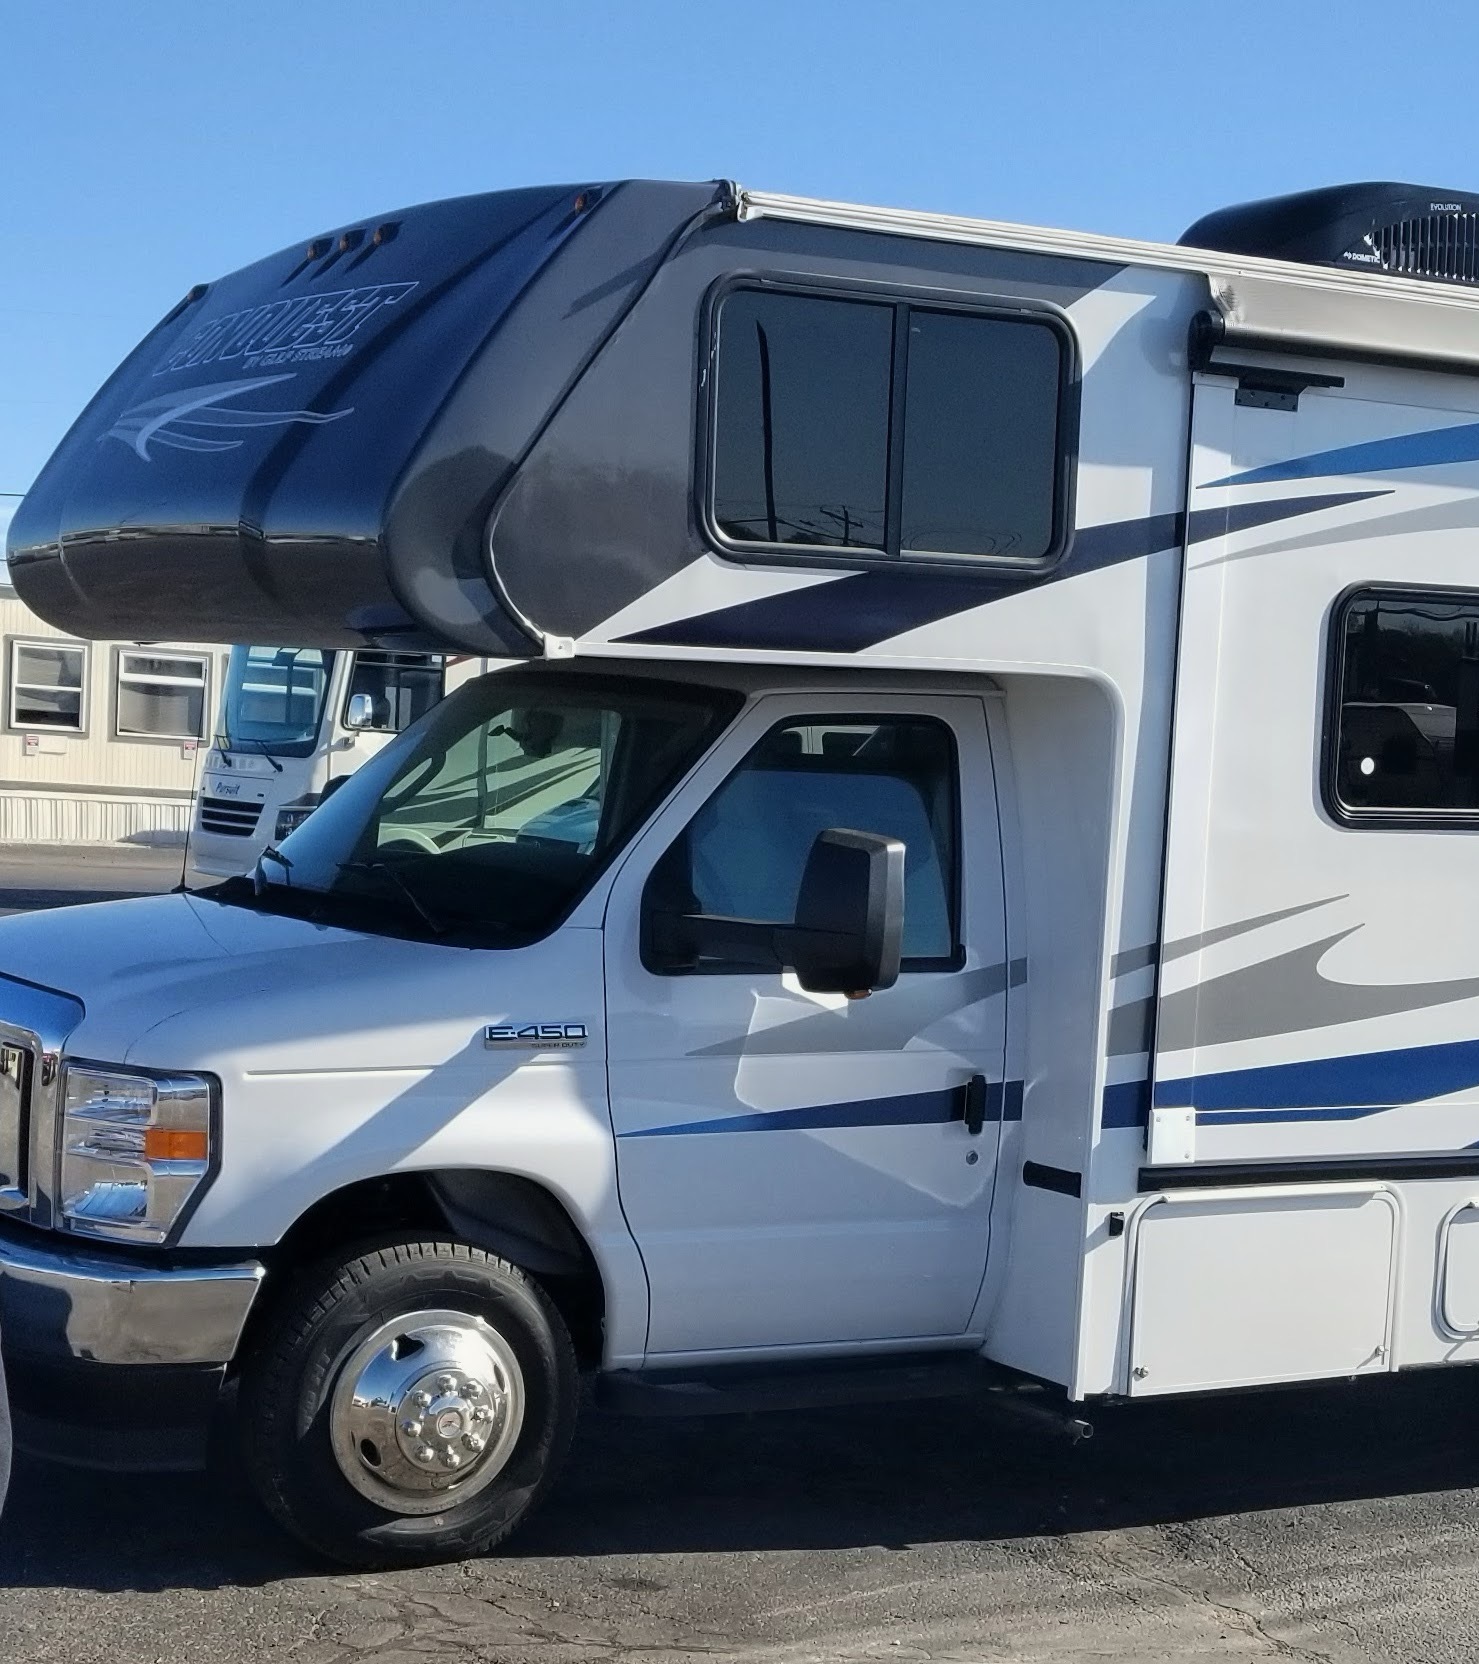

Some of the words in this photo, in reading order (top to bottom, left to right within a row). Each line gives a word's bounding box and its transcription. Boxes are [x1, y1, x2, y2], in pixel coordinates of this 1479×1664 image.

[1430, 203, 1462, 212] EVOLUTION
[1352, 252, 1381, 263] DOMETIC
[215, 781, 241, 795] Pursuit
[485, 1024, 588, 1040] E-450
[561, 1041, 586, 1049] DUTY
